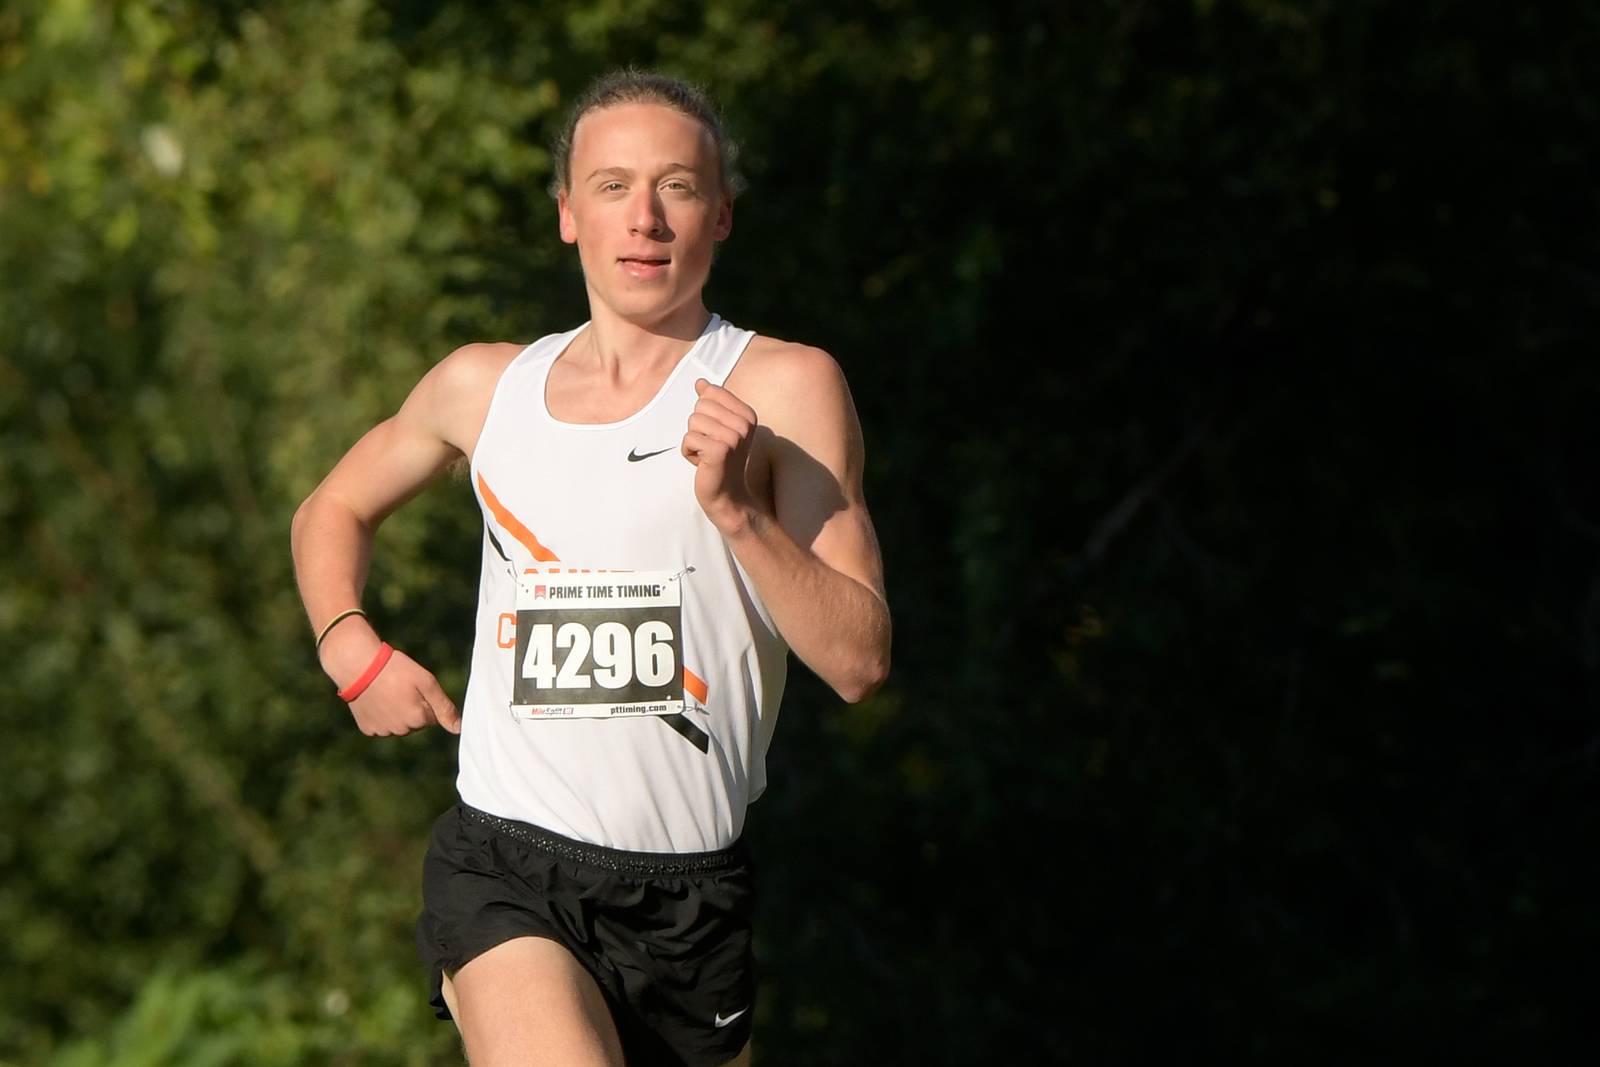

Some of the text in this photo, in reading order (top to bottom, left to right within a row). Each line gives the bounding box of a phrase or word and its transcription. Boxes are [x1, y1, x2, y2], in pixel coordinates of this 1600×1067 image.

[549, 584, 661, 599] PRIME TIME TIMING
[522, 620, 675, 689] 4296
[610, 704, 667, 714] pttiming.com
